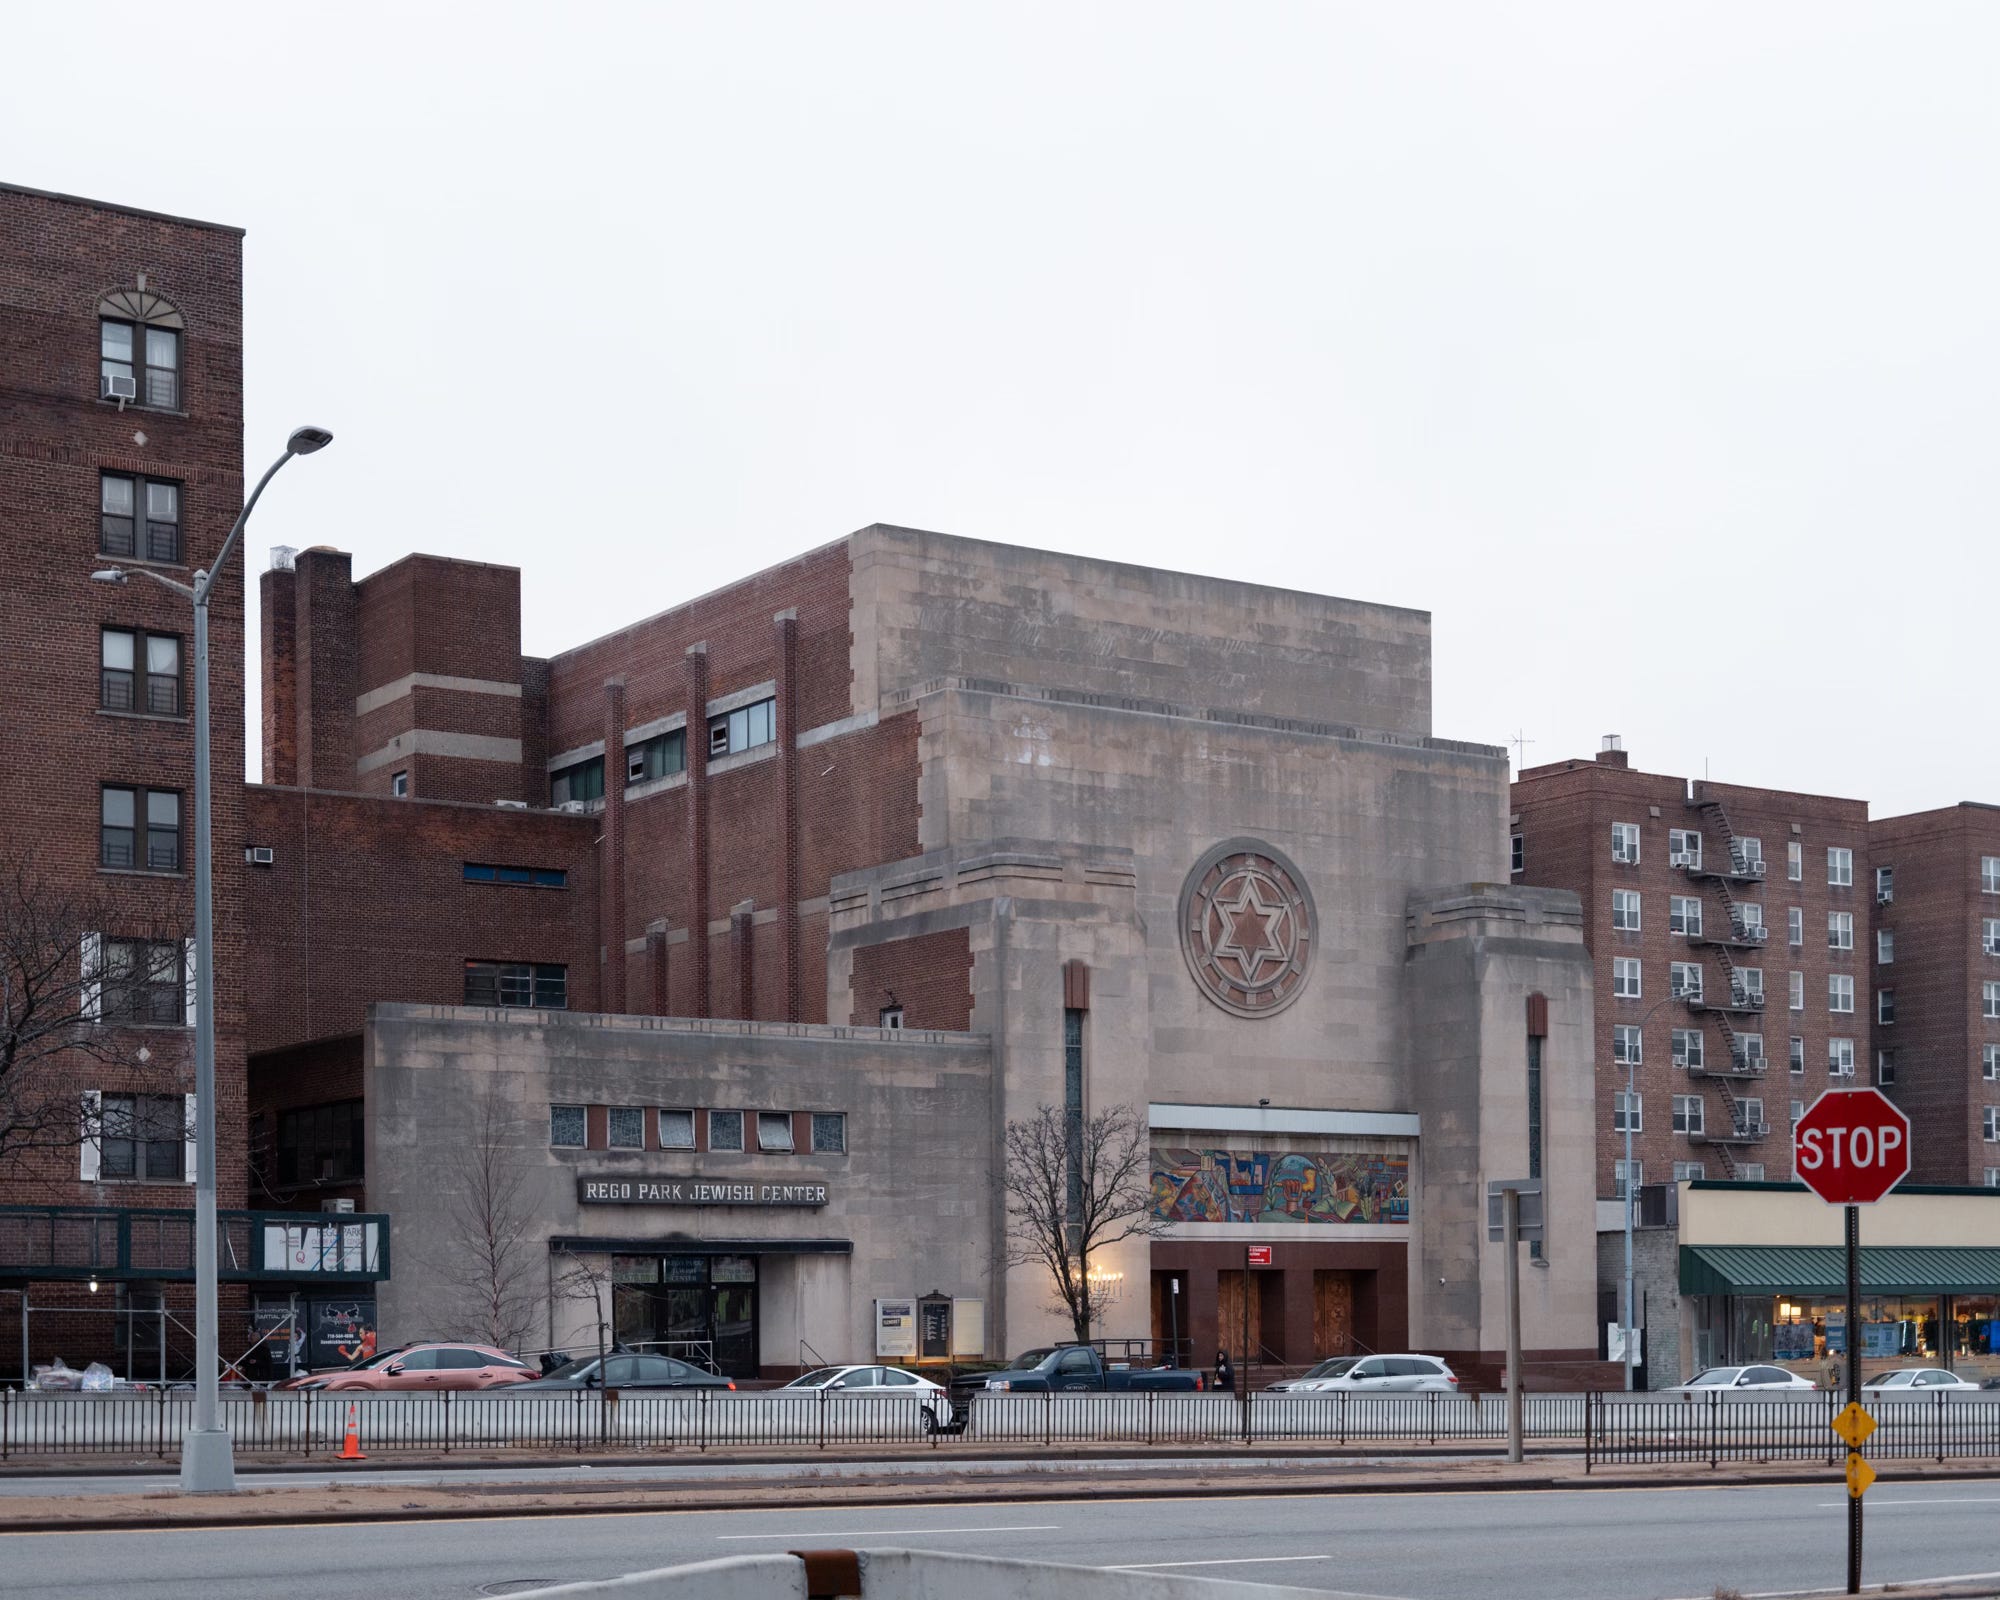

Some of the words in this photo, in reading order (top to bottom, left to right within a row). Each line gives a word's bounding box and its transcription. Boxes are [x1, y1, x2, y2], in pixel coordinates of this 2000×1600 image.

[1801, 1126, 1902, 1170] STOP
[586, 1183, 631, 1199] REGO
[638, 1184, 682, 1200] PARK
[689, 1185, 755, 1201] JEWISH
[761, 1186, 827, 1202] CENTER
[295, 1251, 306, 1264] Q
